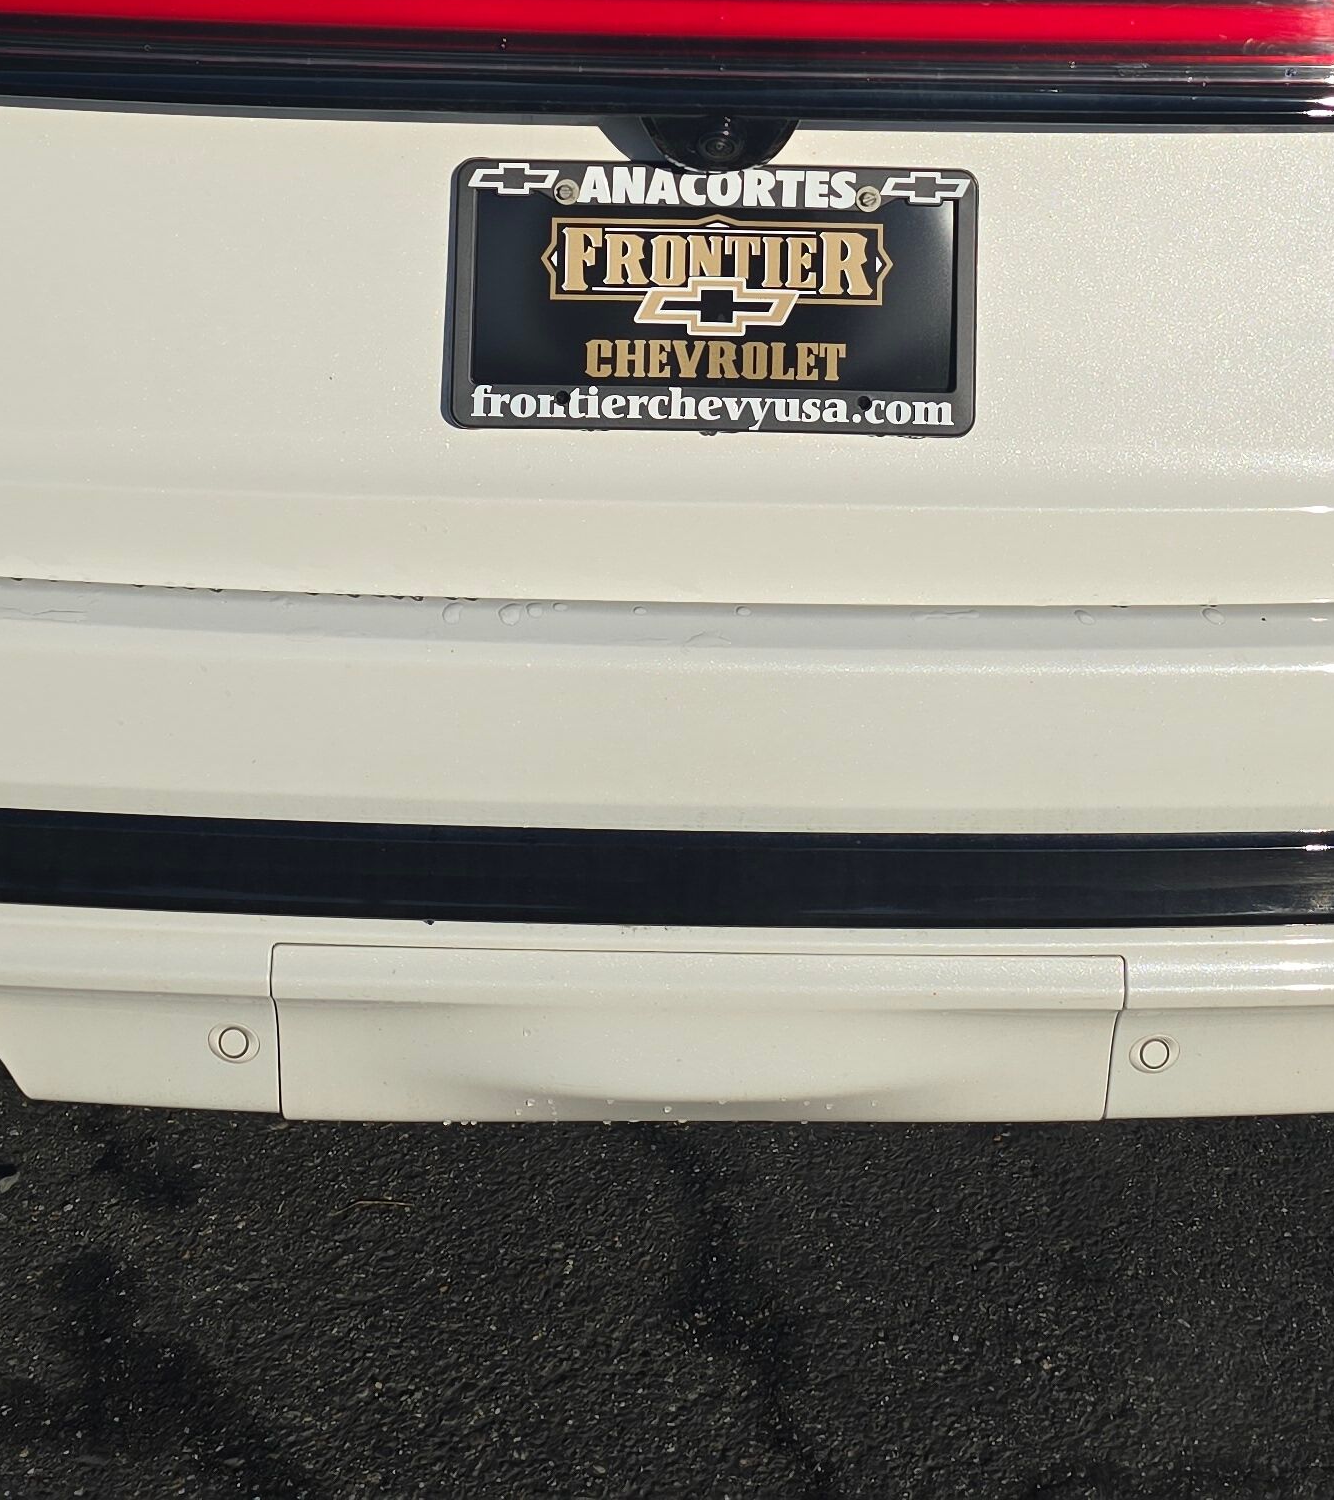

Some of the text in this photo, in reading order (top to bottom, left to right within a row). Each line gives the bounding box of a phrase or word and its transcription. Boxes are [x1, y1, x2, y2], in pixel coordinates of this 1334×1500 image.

[576, 166, 858, 209] ANACORTES
[561, 226, 873, 297] FRONTIER
[585, 339, 847, 382] CHEVROLET
[470, 386, 955, 430] frontierchevyusa.com
